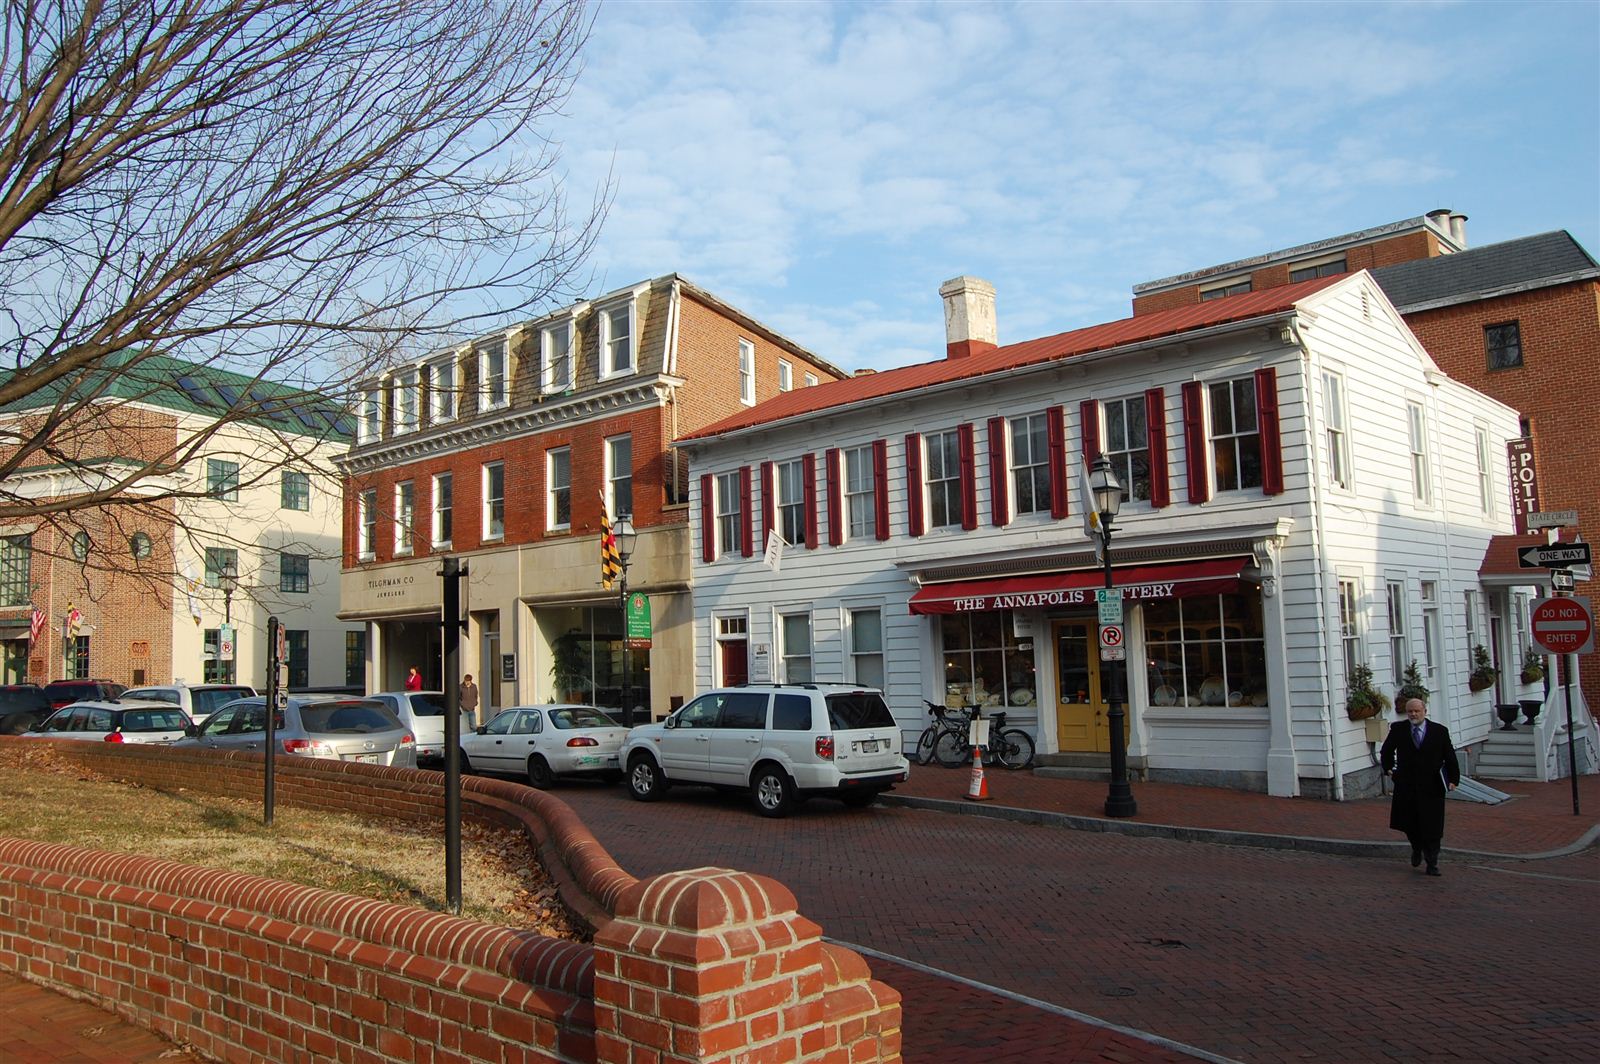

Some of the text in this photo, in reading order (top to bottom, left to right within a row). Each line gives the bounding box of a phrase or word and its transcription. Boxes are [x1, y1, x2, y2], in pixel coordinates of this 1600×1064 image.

[1510, 454, 1522, 515] ANNAPOLIS
[1530, 511, 1575, 521] STATE CIRCLE
[1539, 550, 1582, 561] ONE WAY
[368, 576, 414, 588] TILGHMAN CO
[953, 583, 1175, 611] THE ANNAPOLIS TTERY
[1100, 591, 1105, 601] 2
[1542, 608, 1578, 618] DO NOT
[1546, 633, 1577, 643] ENTER
